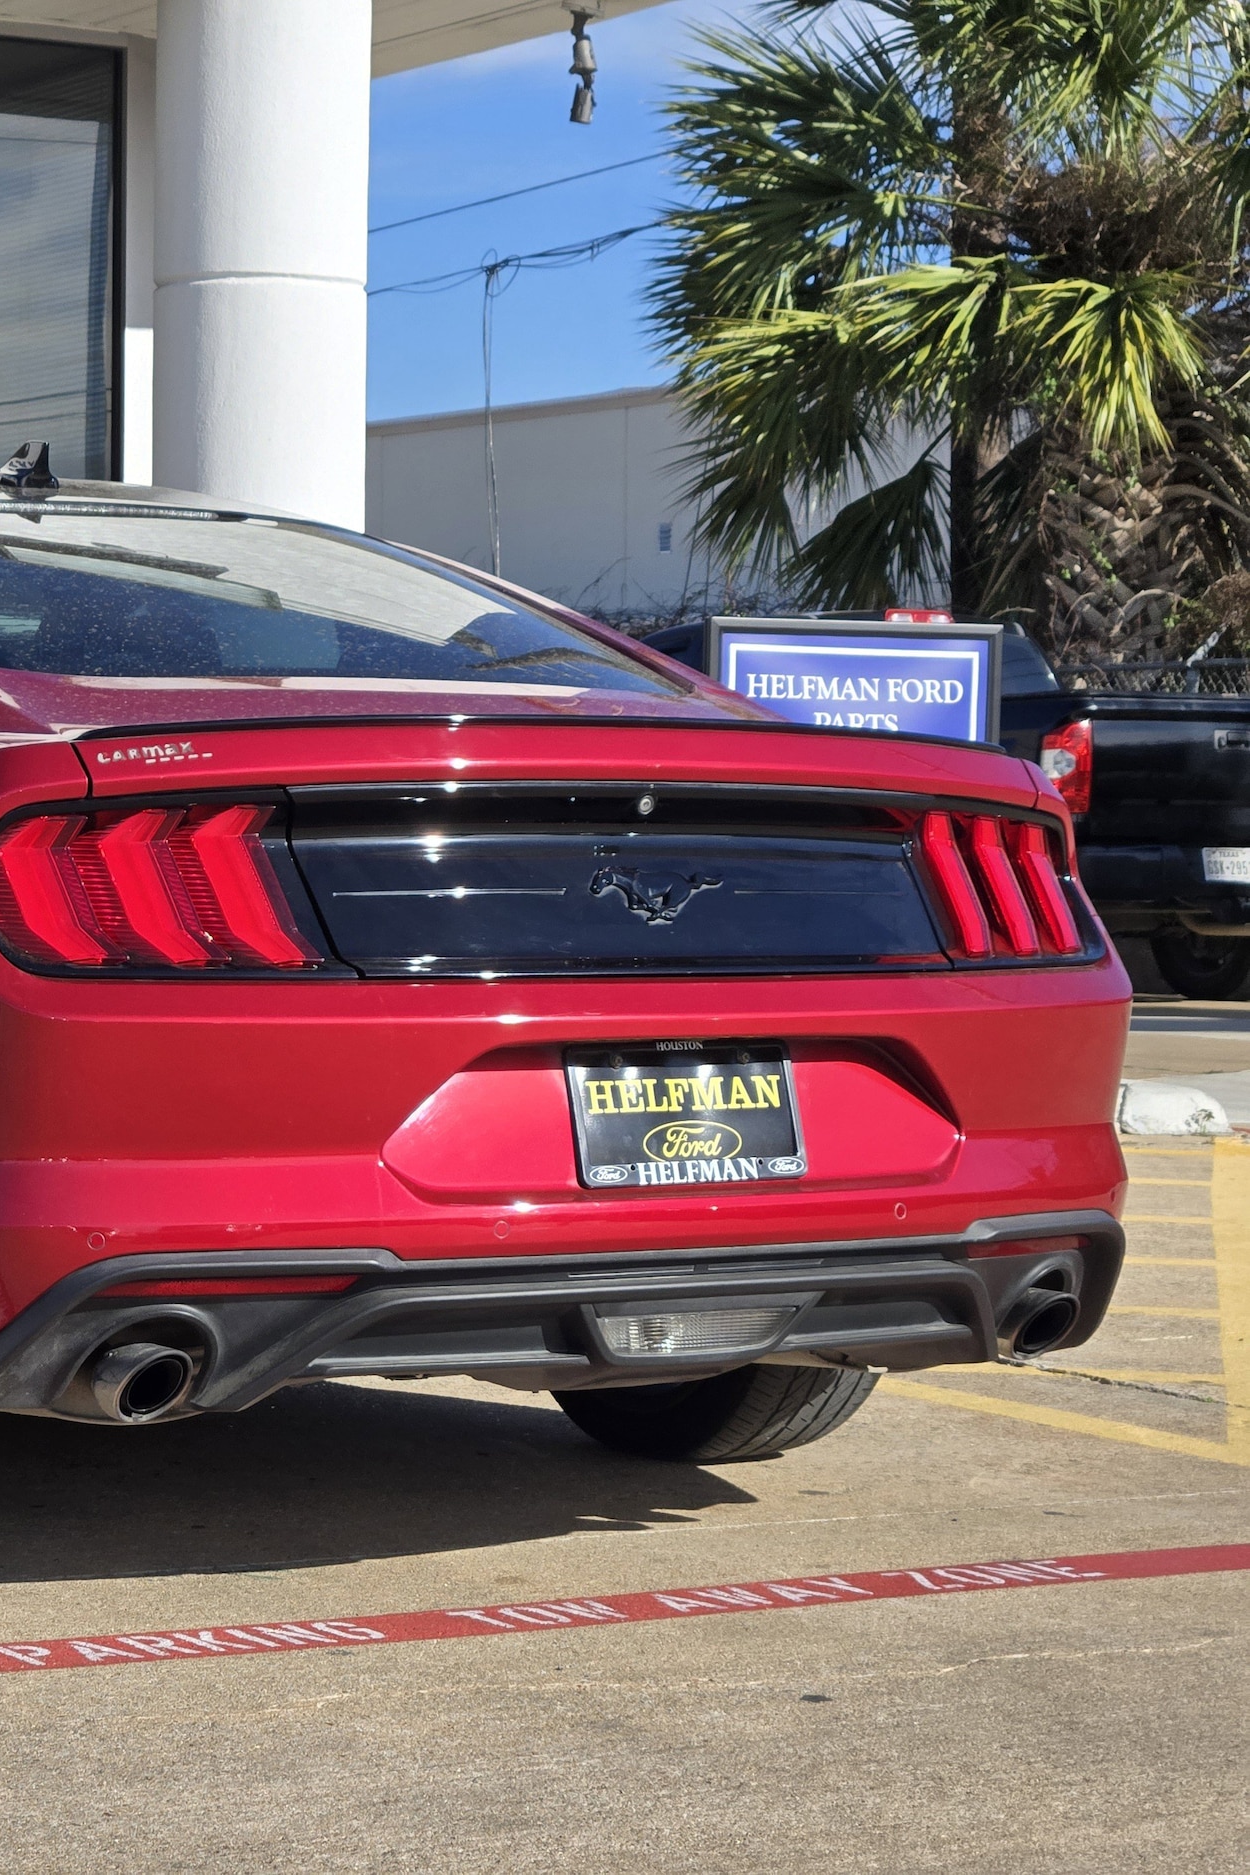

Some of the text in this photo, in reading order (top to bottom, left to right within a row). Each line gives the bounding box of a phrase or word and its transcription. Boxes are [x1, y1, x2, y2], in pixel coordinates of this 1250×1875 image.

[747, 673, 964, 704] HELFMAN FORD
[656, 1041, 704, 1051] HOUSTON
[585, 1075, 780, 1114] HELFMAN
[662, 1126, 723, 1158] Ford
[636, 1157, 759, 1185] HELFMAN
[445, 1600, 629, 1630] TOW
[652, 1575, 874, 1614] AWAY
[881, 1559, 1104, 1591] ZONE
